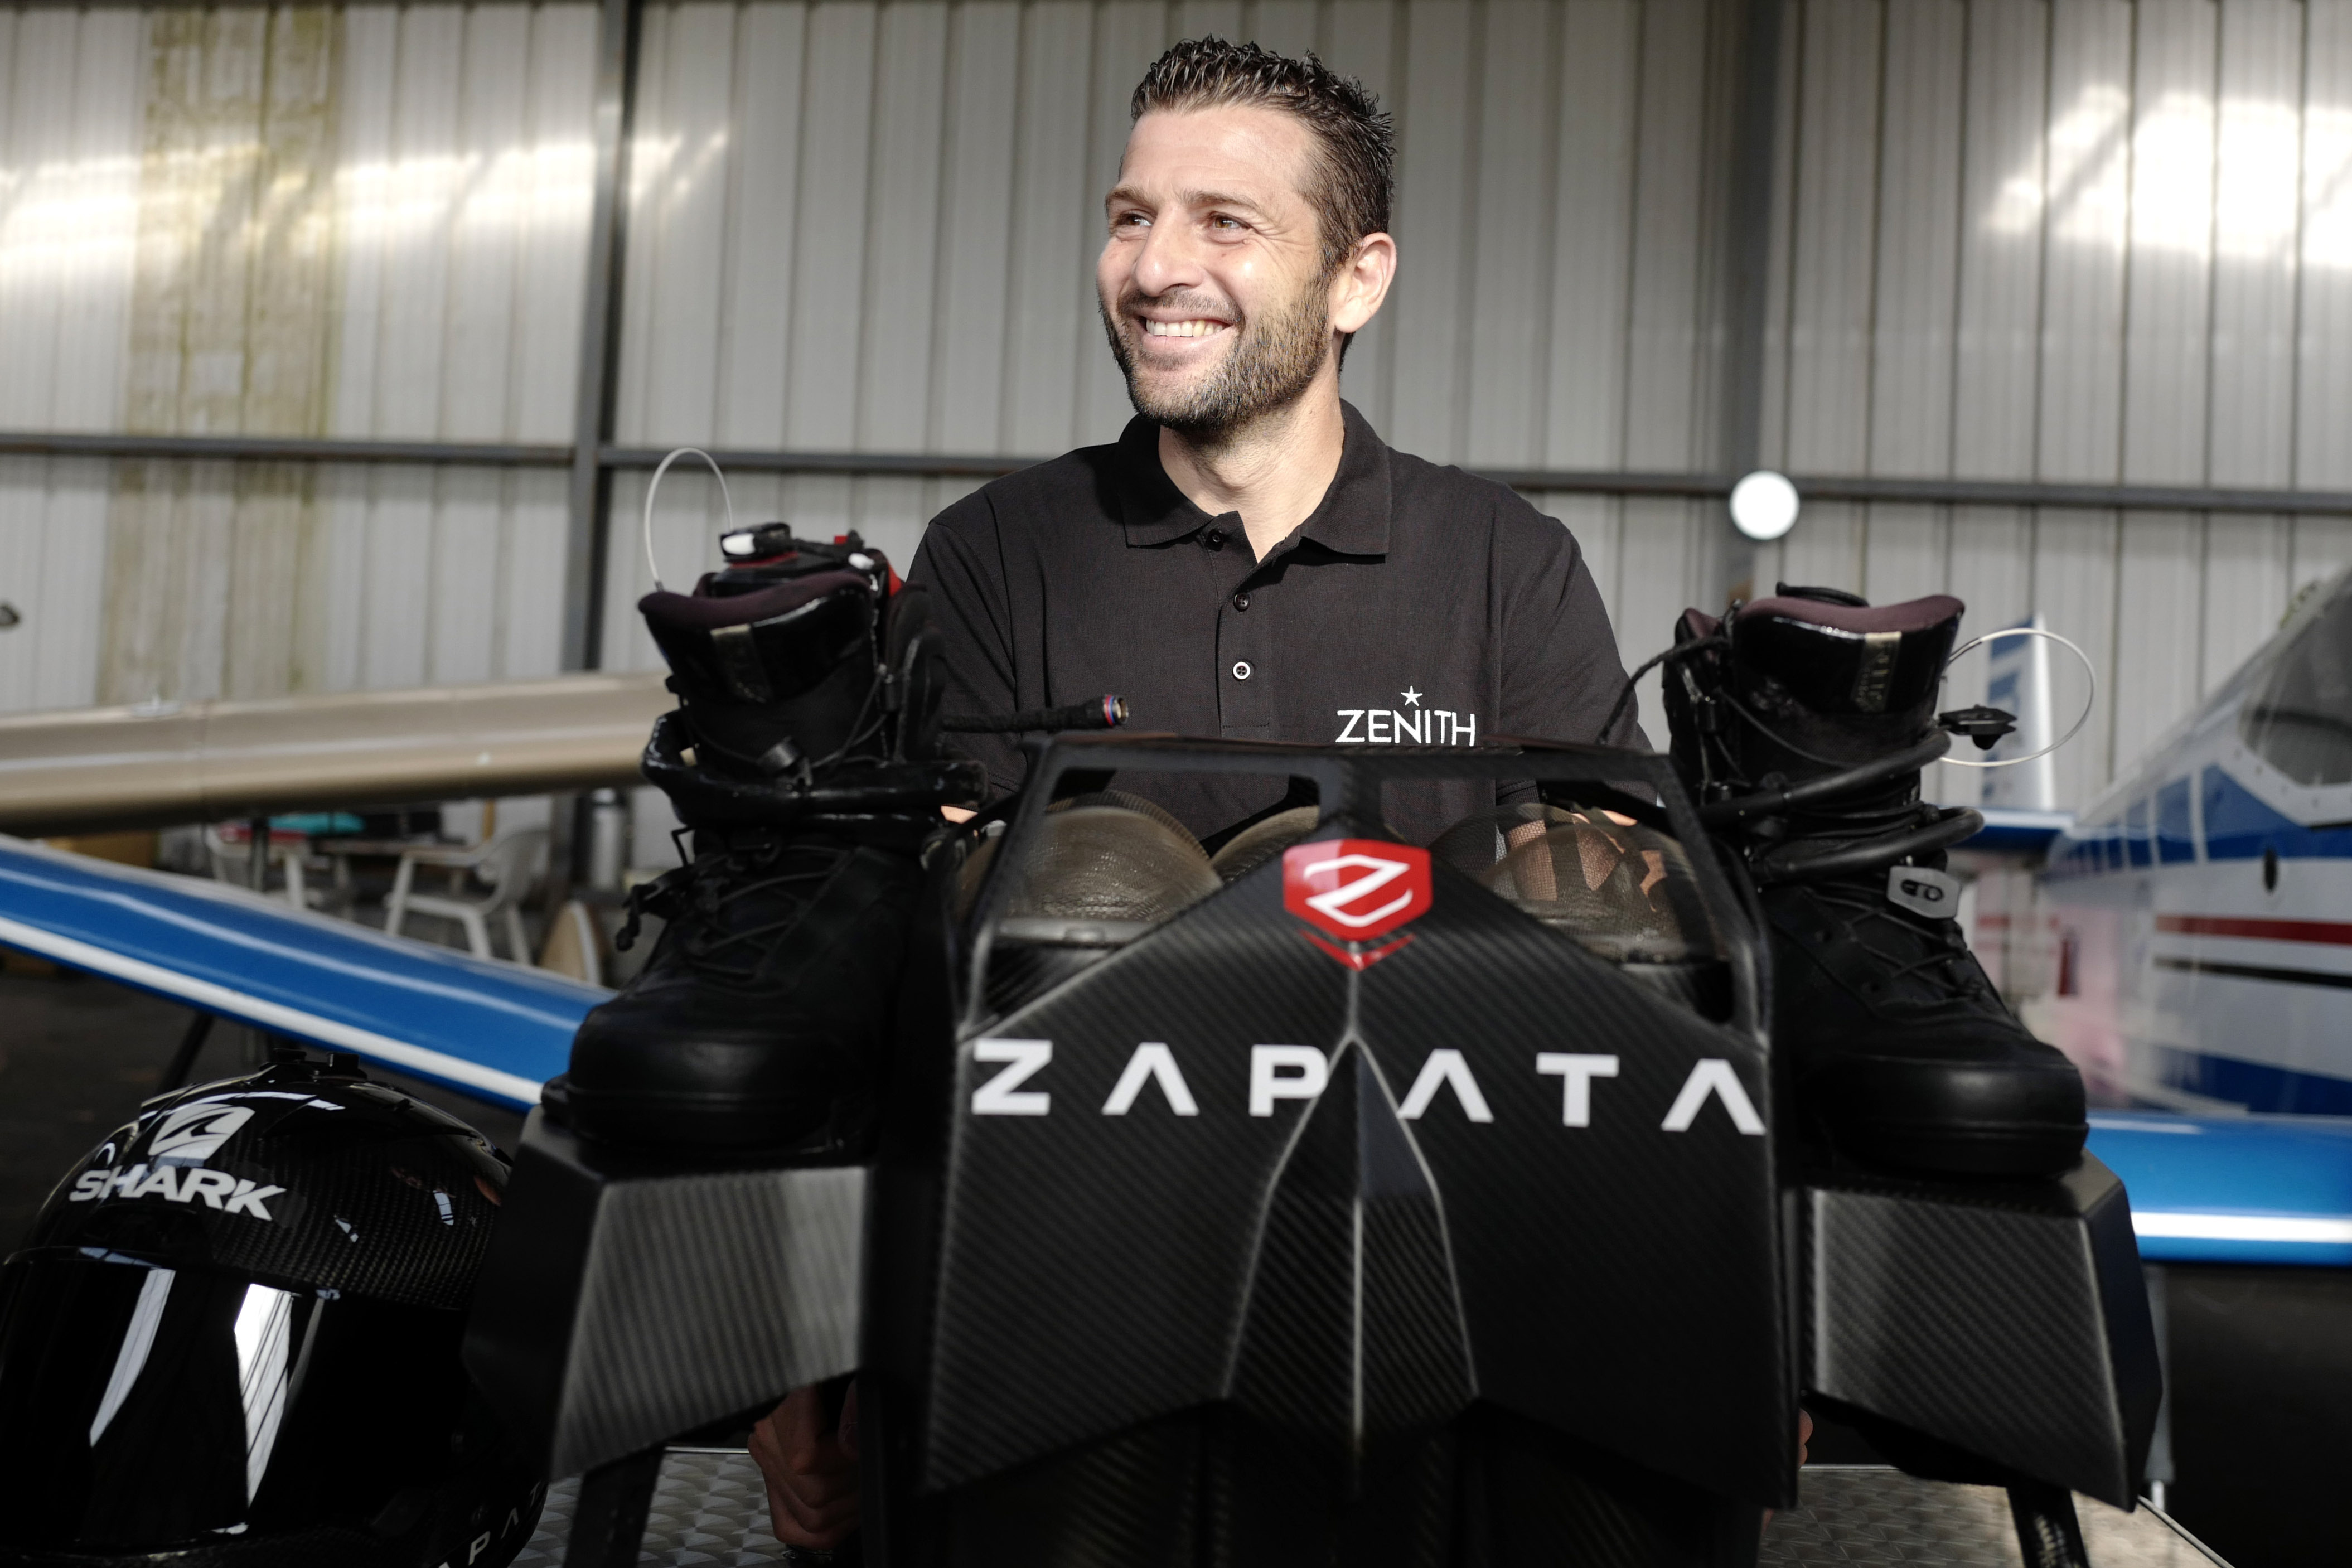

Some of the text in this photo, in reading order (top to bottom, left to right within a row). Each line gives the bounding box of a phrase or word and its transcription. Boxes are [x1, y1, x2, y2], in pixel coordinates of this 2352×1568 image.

[1335, 709, 1476, 747] ZENITH
[971, 1039, 1765, 1136] ZAPATA
[69, 1164, 287, 1221] SHARK
